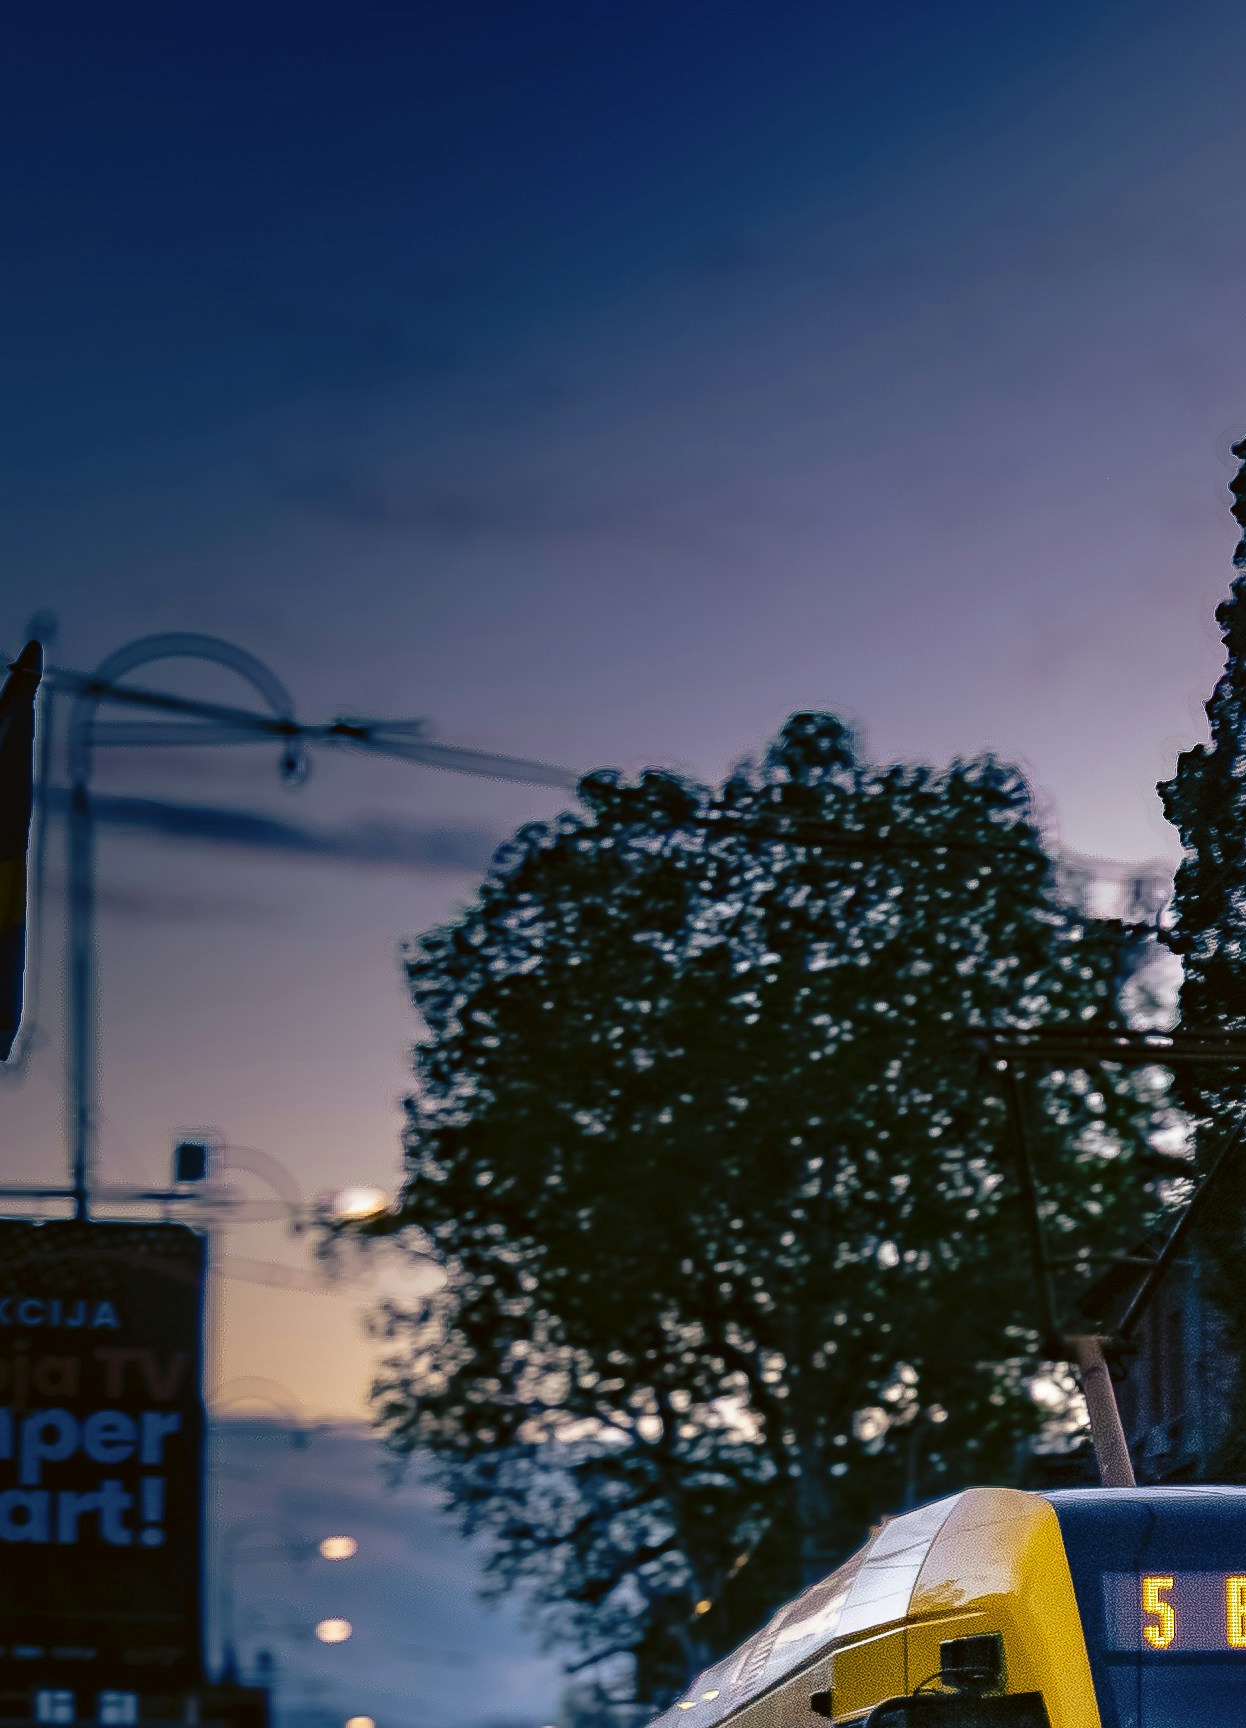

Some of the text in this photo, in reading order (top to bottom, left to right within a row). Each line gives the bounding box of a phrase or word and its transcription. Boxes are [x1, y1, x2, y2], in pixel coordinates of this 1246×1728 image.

[0, 1338, 189, 1413] ja TV
[0, 1407, 182, 1485] per
[1143, 1576, 1175, 1648] 5
